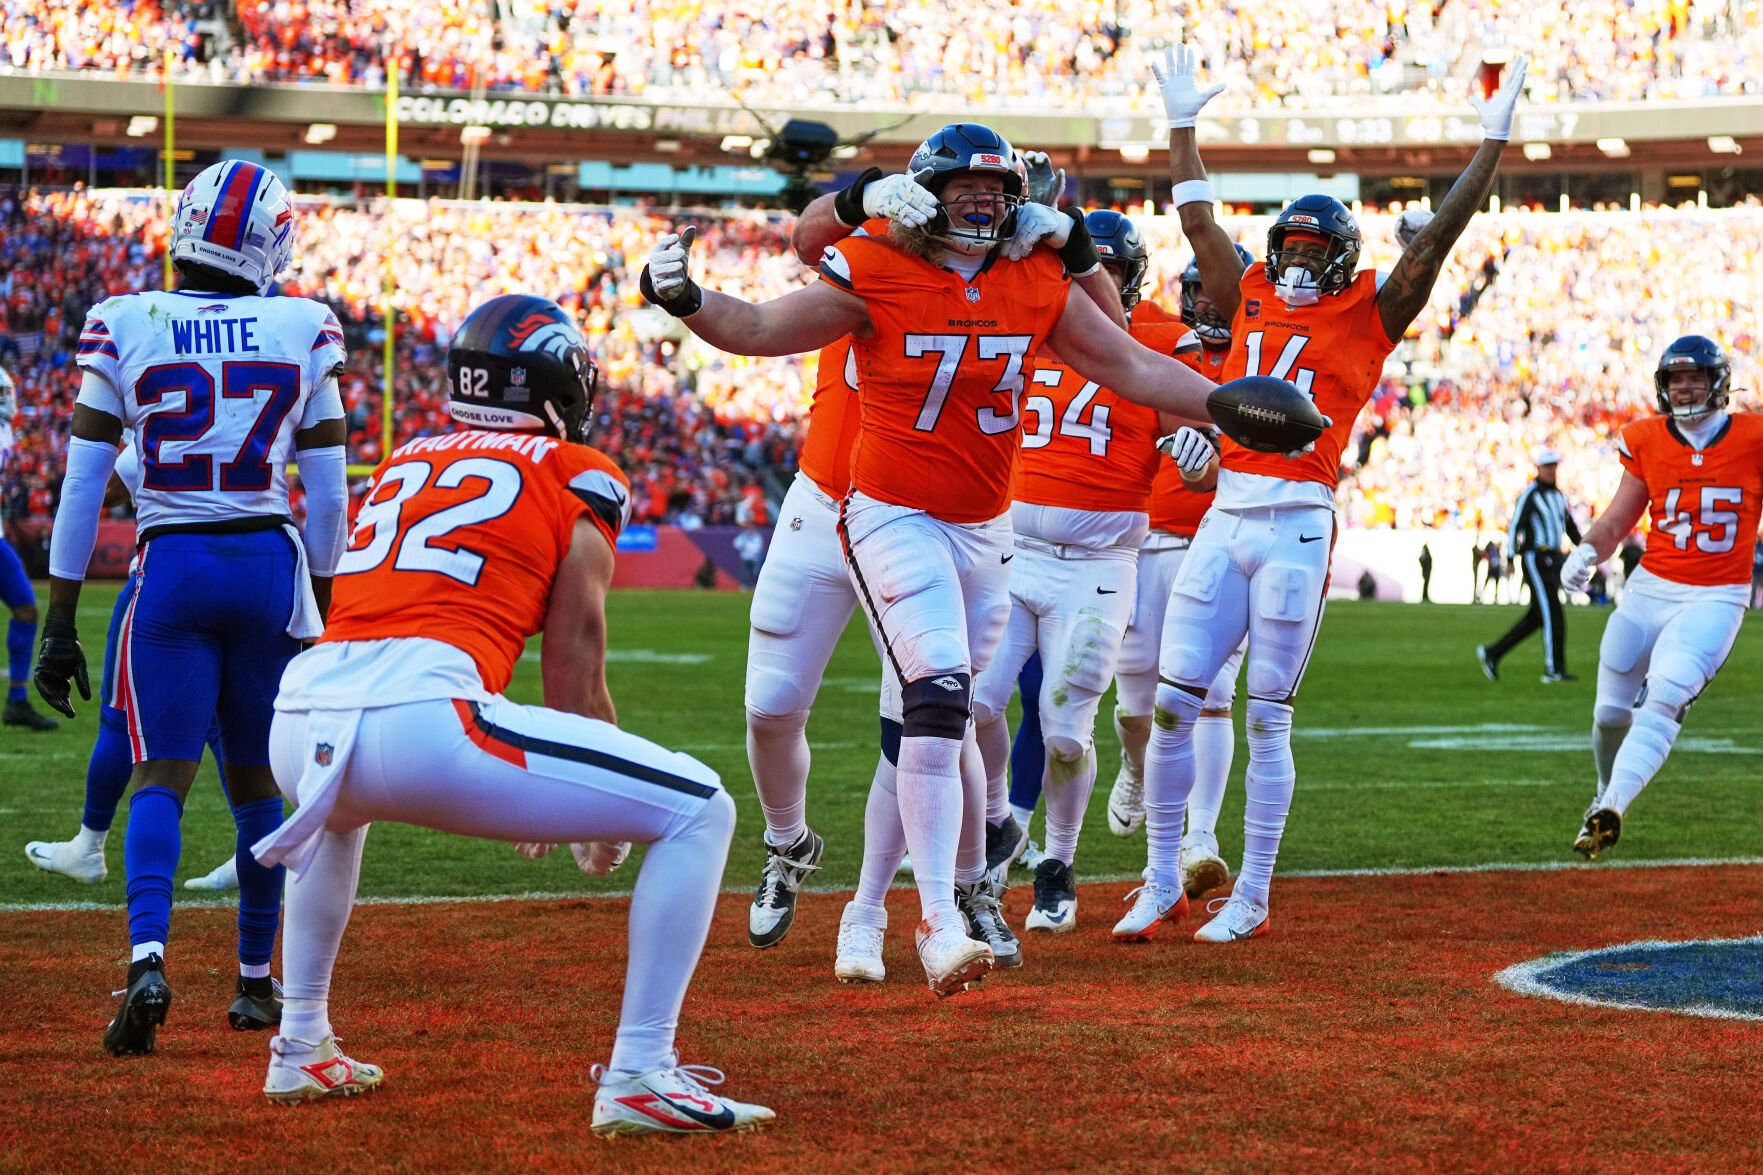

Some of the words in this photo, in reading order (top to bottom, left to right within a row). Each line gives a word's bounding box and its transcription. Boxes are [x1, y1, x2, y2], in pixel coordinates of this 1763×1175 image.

[199, 246, 221, 258] CHOOSE
[221, 253, 237, 263] LOVE
[948, 319, 998, 328] BRONCOS
[1245, 300, 1261, 317] C
[171, 317, 259, 354] WHITE
[1264, 320, 1310, 332] BRONCOS
[460, 366, 489, 398] 82
[1245, 330, 1317, 401] 14
[904, 333, 1035, 435] 73
[135, 361, 300, 491] 27
[451, 407, 481, 422] CHOOSE
[484, 414, 514, 424] LOVE
[333, 457, 523, 587] 82
[1657, 486, 1743, 553] 45
